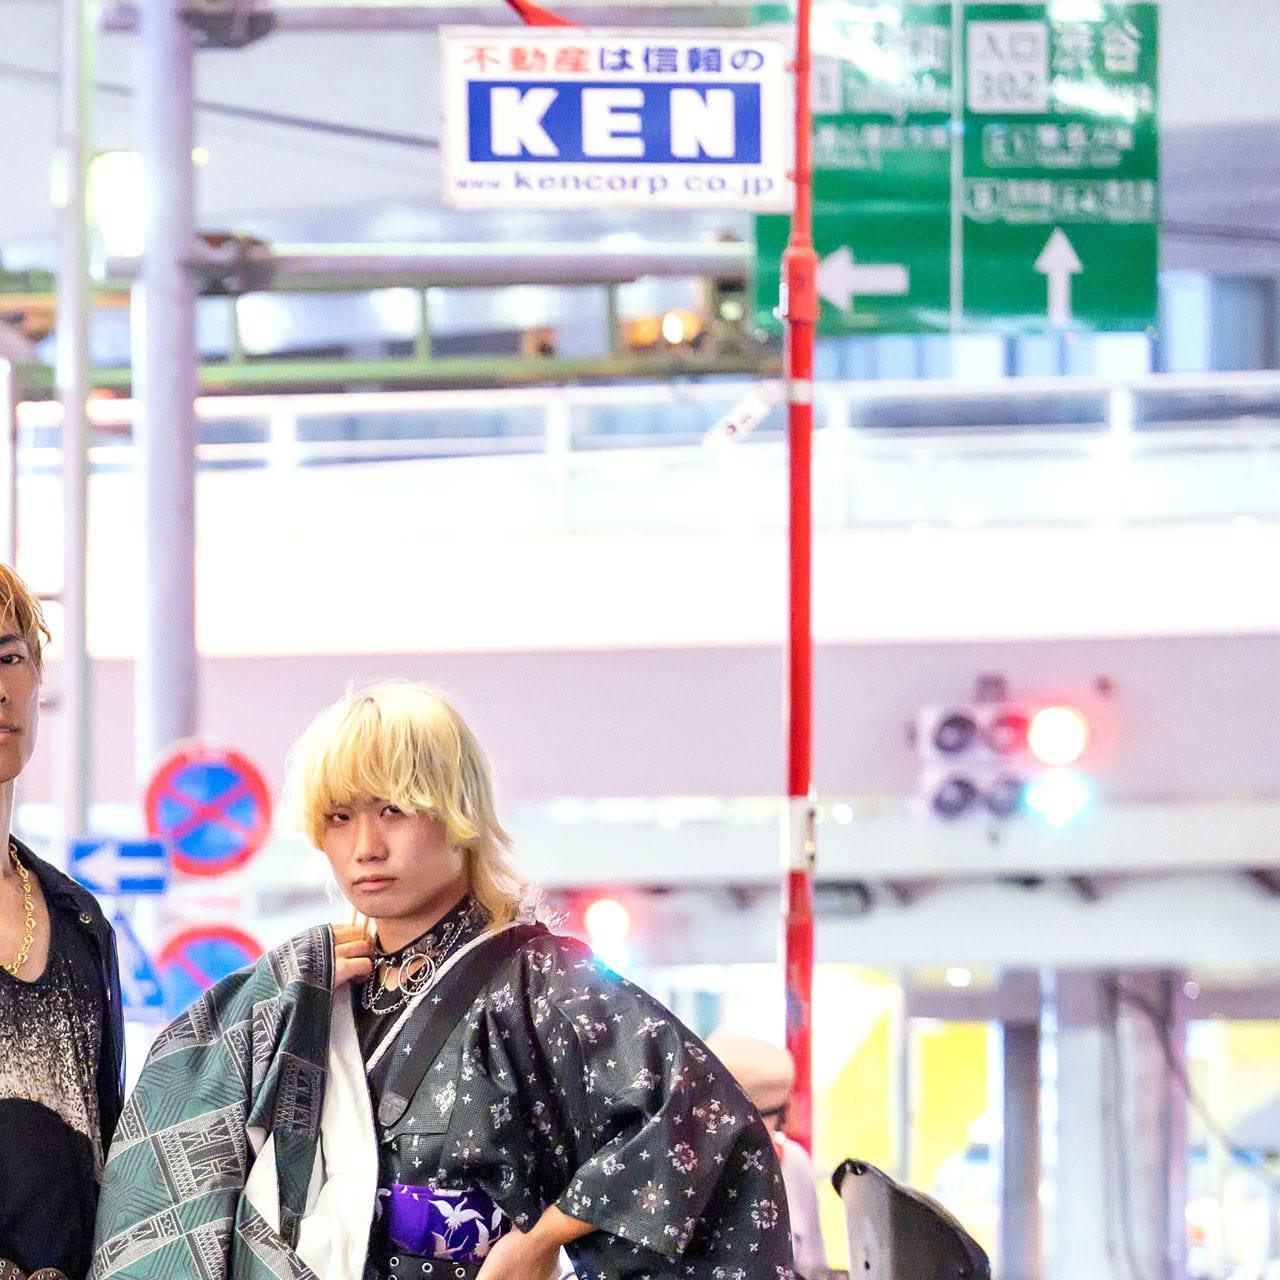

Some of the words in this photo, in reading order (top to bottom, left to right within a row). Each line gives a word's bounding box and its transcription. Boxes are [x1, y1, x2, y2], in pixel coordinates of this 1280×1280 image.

[462, 45, 765, 74] 不動産は信頼の
[490, 86, 737, 159] KEN
[454, 171, 775, 197] www.kencorp.co.jp
